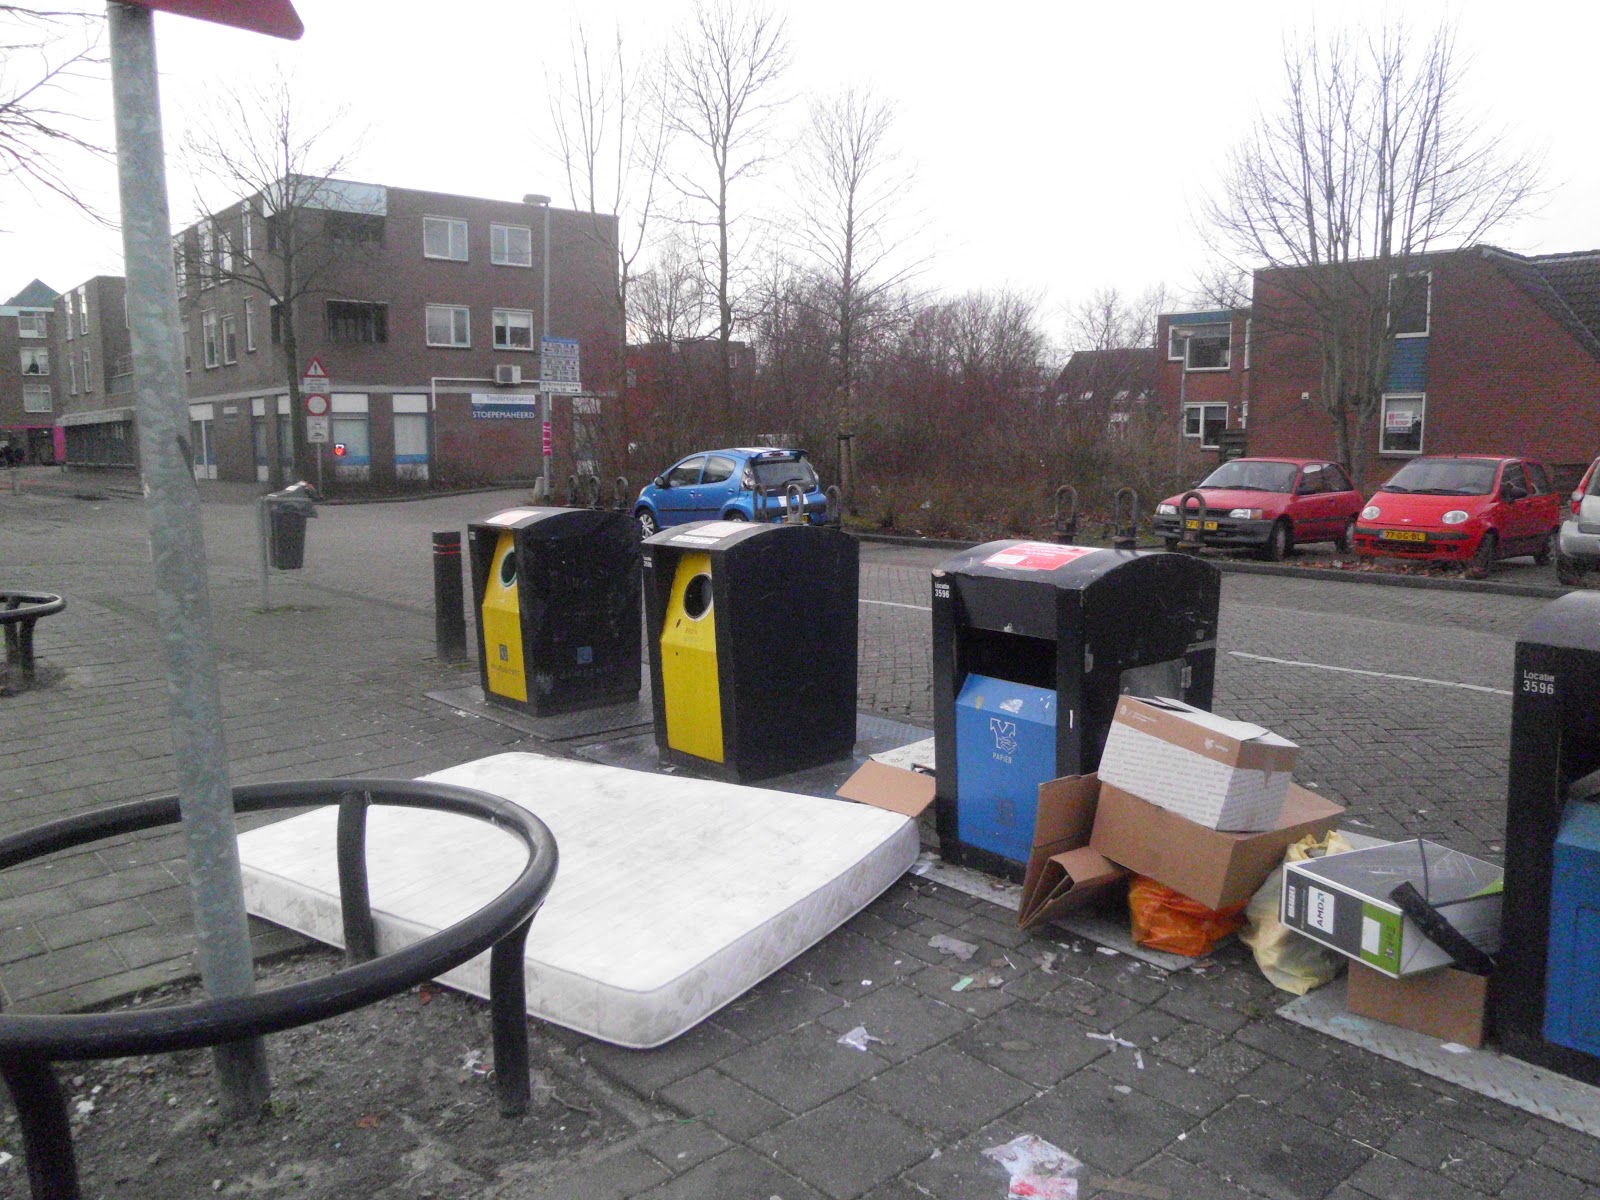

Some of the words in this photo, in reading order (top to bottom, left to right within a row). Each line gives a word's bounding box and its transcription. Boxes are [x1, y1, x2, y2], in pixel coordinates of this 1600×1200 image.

[934, 588, 950, 599] 3596
[1523, 680, 1554, 695] 3596
[1316, 901, 1325, 928] AMD
